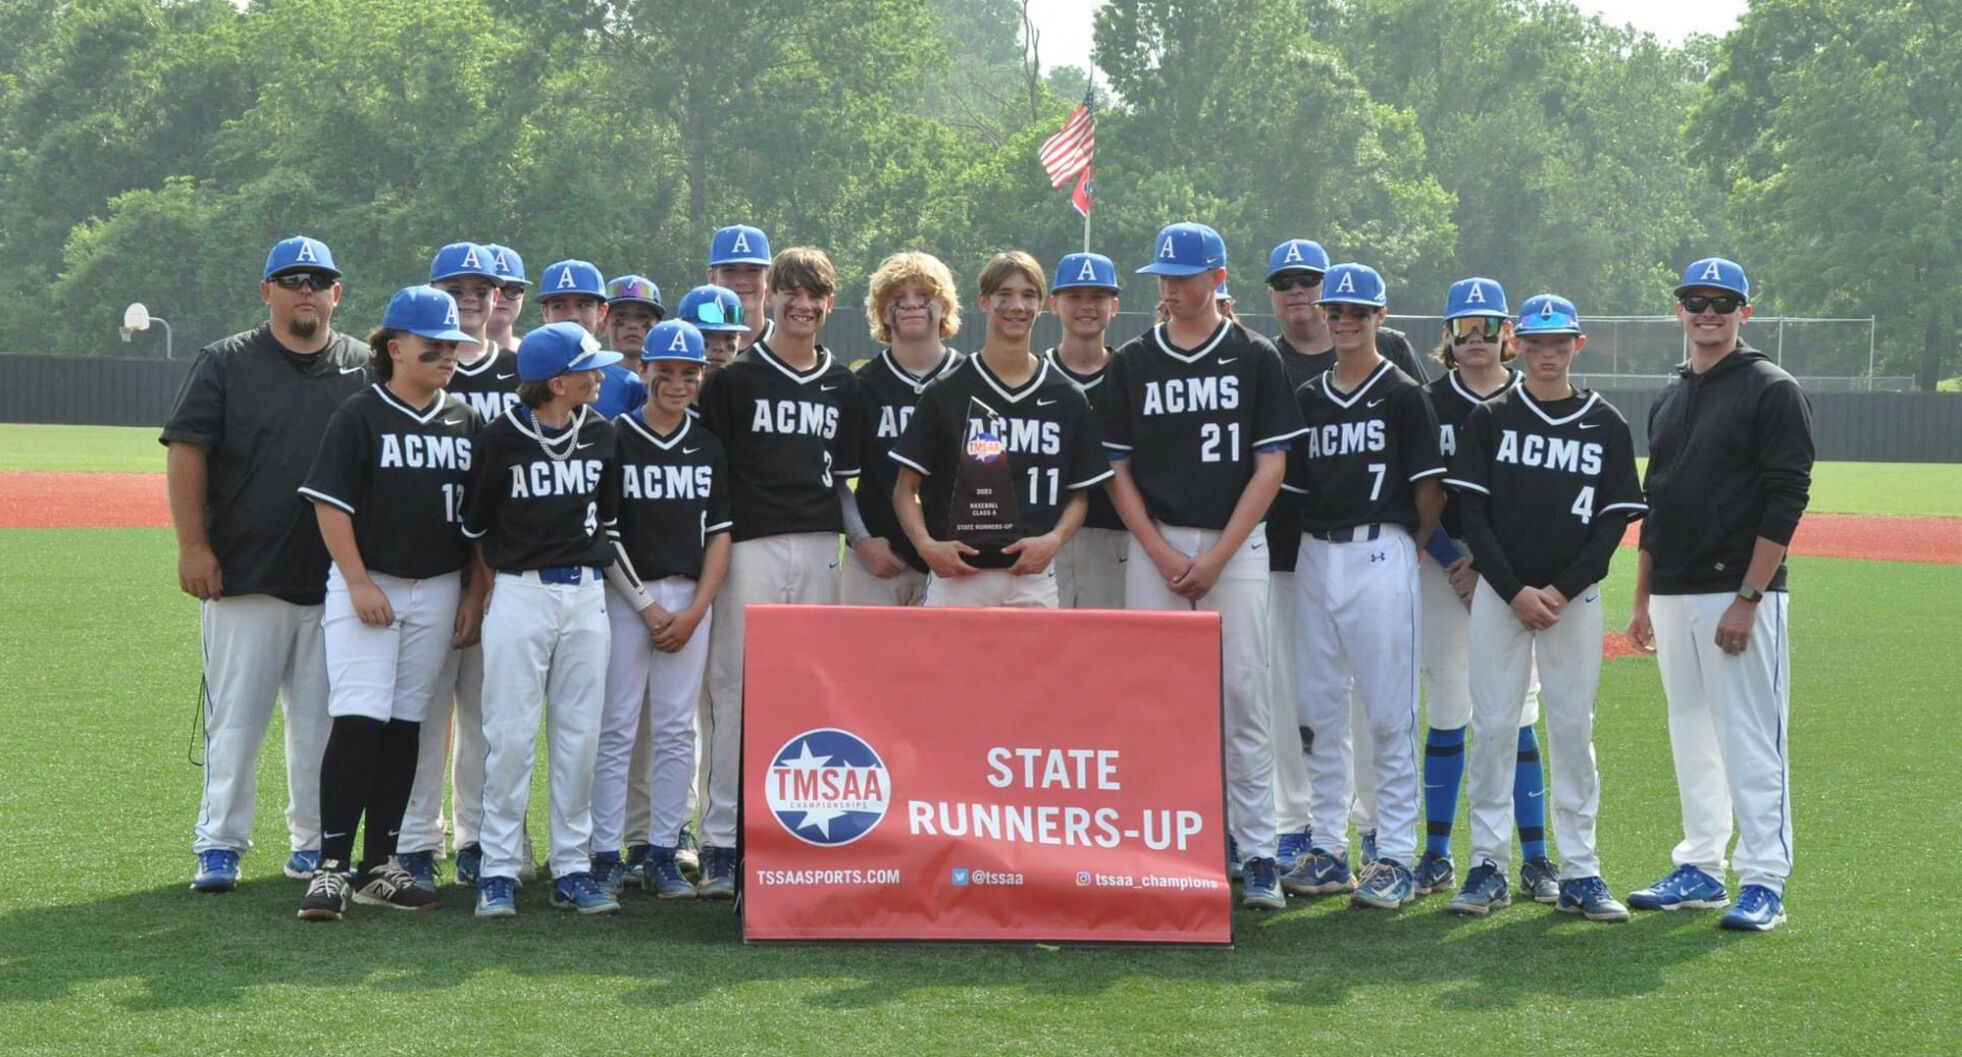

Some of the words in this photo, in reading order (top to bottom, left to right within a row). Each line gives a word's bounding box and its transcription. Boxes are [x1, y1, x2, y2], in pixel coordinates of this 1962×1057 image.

[296, 241, 318, 262] A
[731, 232, 752, 253] A
[1159, 235, 1177, 259] A
[1284, 242, 1304, 263] A
[460, 248, 482, 270] A
[494, 249, 511, 272] A
[1077, 258, 1097, 281] A
[1697, 257, 1722, 281] A
[556, 266, 577, 289] A
[1336, 270, 1356, 293] A
[1465, 281, 1486, 304] A
[443, 299, 459, 325] A
[668, 328, 689, 353] A
[1143, 375, 1240, 416] ACMS
[751, 399, 840, 440] ACMS
[967, 416, 1061, 455] ACMS
[1201, 422, 1240, 463] 21
[1309, 419, 1387, 459] ACMS
[380, 433, 472, 471] ACMS
[1496, 429, 1604, 477] ACMS
[508, 459, 604, 498] ACMS
[623, 464, 713, 500] ACMS
[1027, 466, 1060, 506] 11
[1367, 463, 1387, 501] 7
[1571, 485, 1596, 525] 4
[986, 747, 1121, 790] STATE
[773, 768, 883, 802] TMSAA
[908, 800, 1203, 850] RUNNERS-UP
[757, 869, 900, 885] TSSAASPORTS.COM
[972, 870, 1024, 885] @tssaa
[1095, 873, 1219, 892] tssaa_champions
